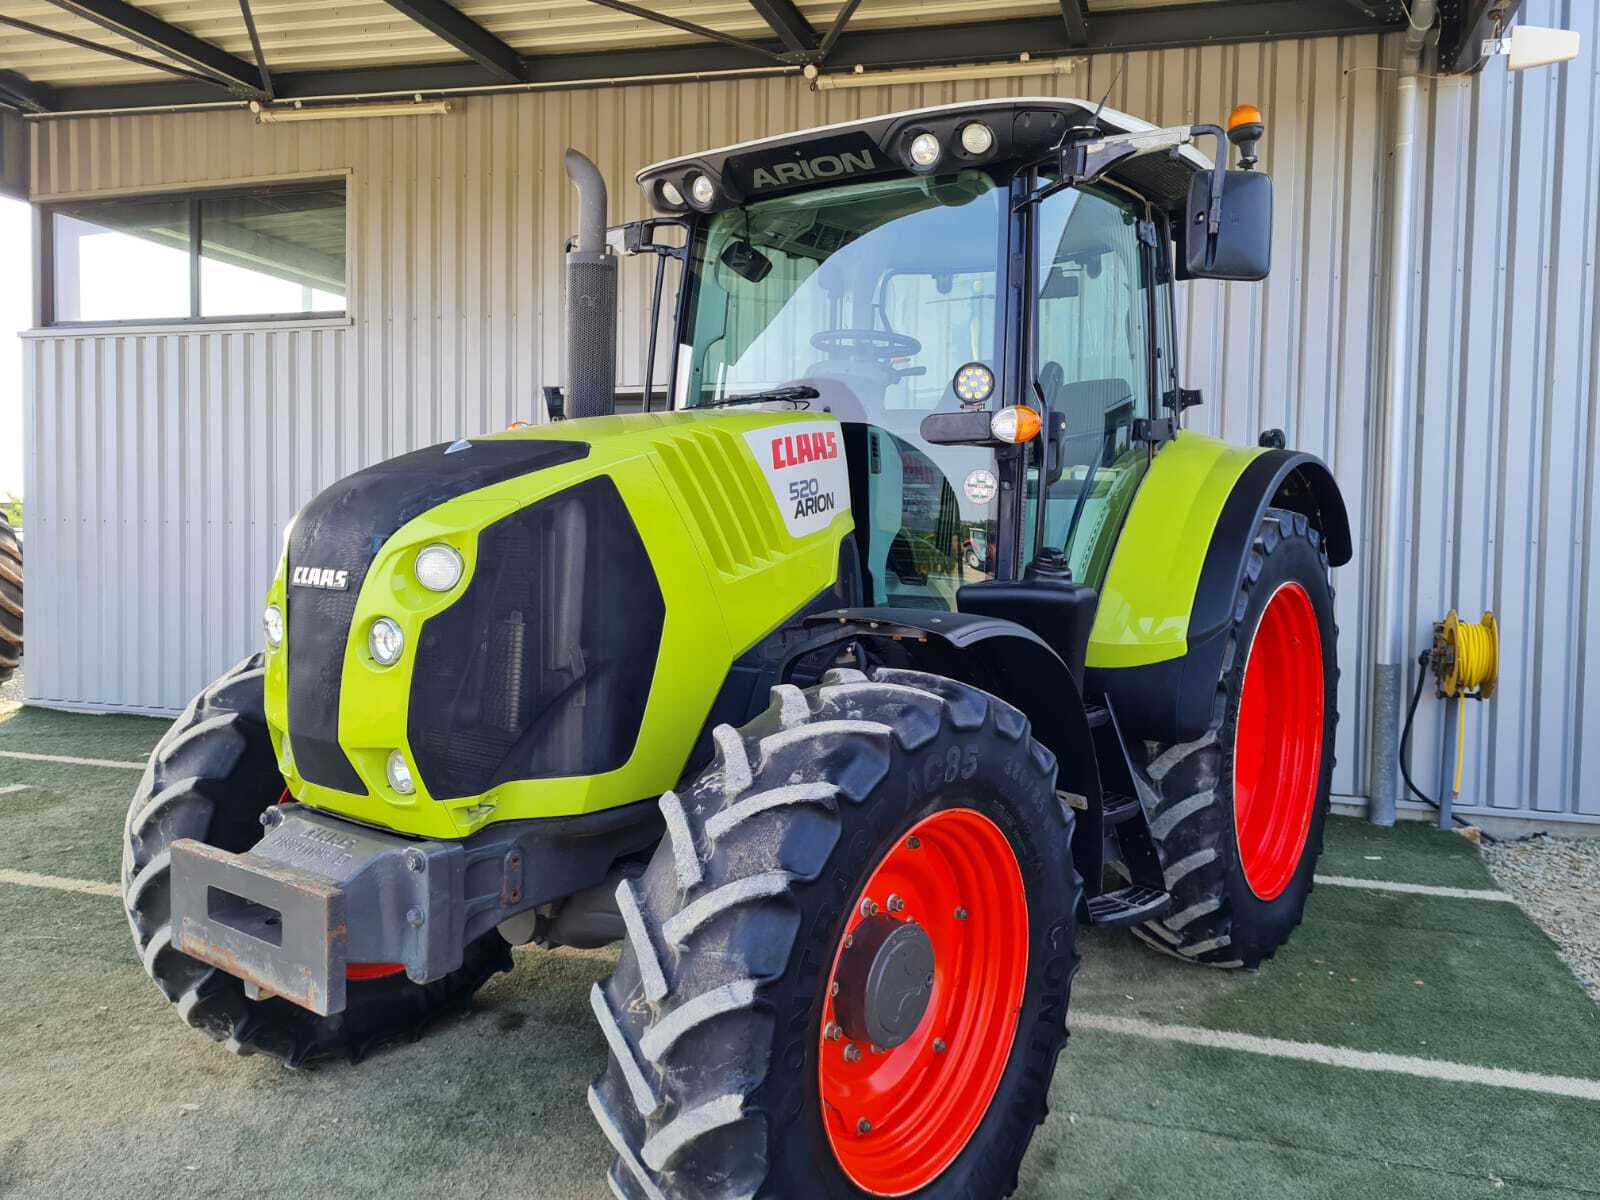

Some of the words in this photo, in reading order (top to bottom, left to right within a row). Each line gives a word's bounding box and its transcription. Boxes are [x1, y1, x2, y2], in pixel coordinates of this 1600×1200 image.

[753, 149, 876, 189] ARION
[771, 431, 838, 470] CLAAS
[789, 478, 819, 501] 520
[794, 491, 835, 519] ARION
[292, 566, 349, 590] CLAAS
